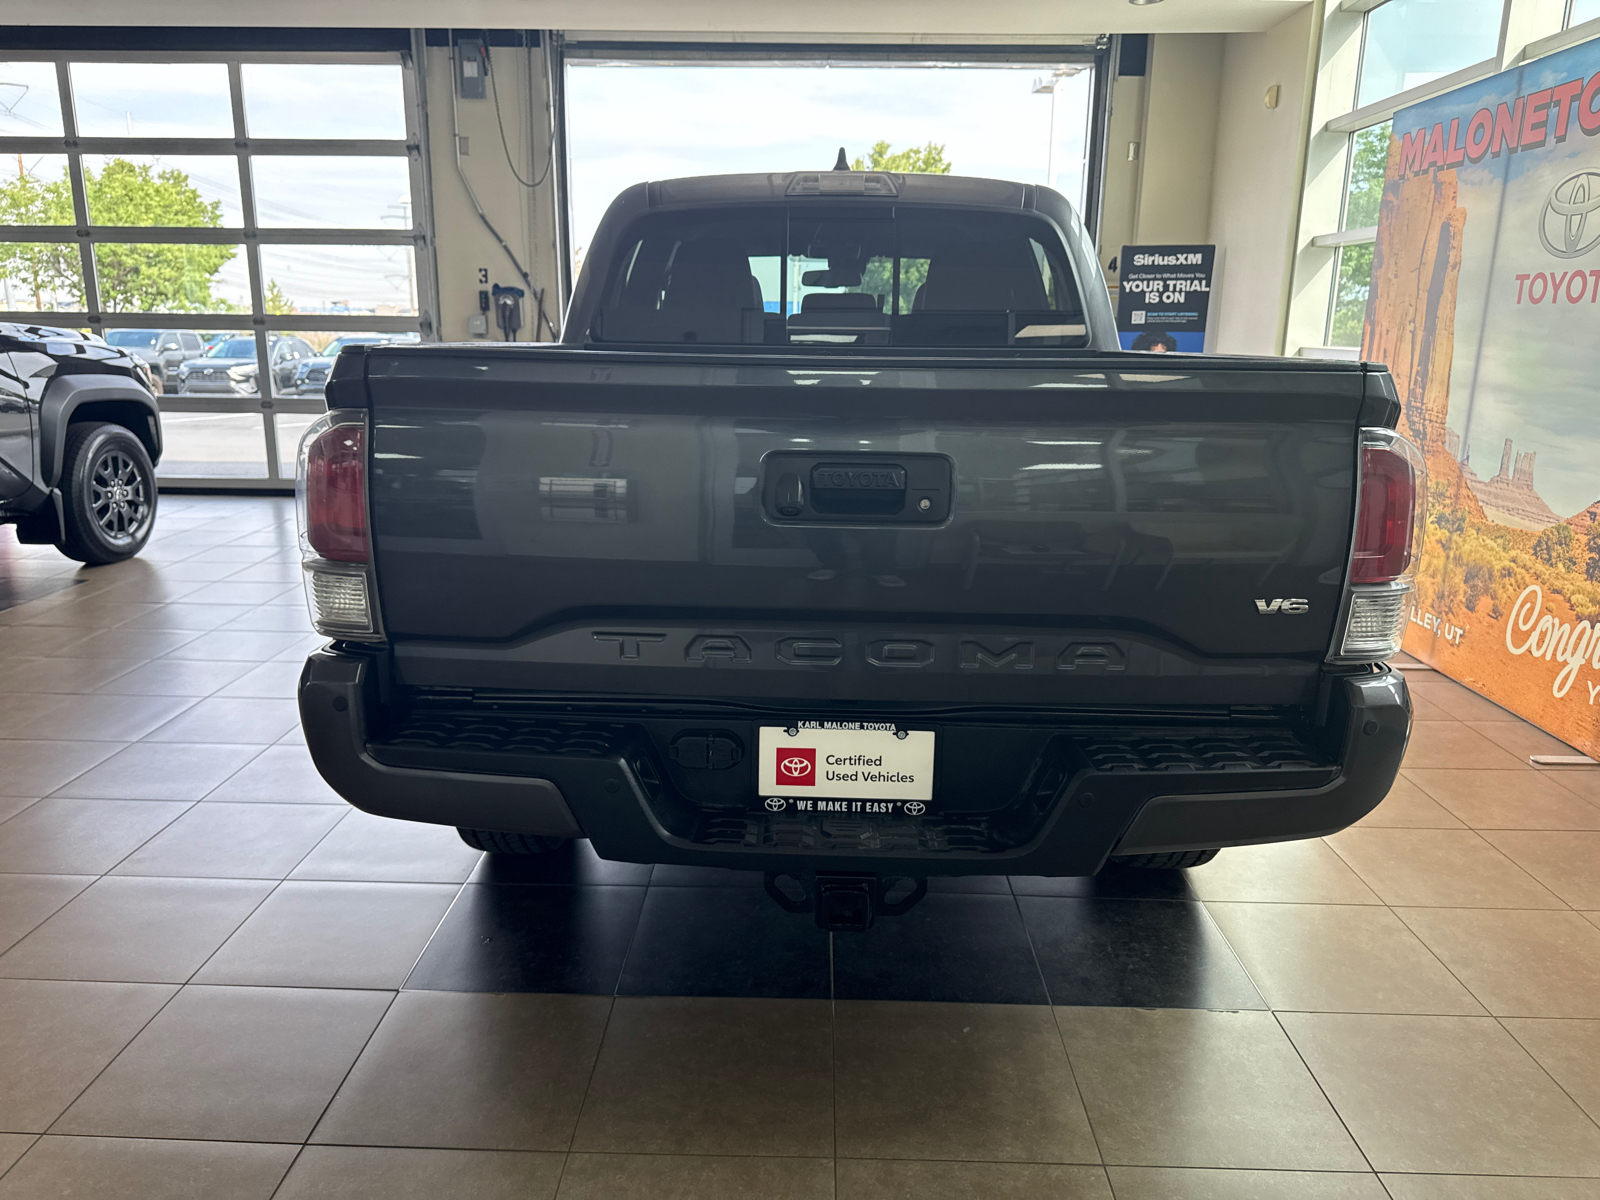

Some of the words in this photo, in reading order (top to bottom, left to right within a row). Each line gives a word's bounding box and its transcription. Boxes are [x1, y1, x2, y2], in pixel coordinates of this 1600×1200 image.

[1108, 256, 1117, 273] 4
[1133, 253, 1202, 266] SiriusXM
[478, 268, 488, 284] 3
[1123, 281, 1164, 292] YOUR
[1166, 280, 1210, 292] TRIAL
[1145, 292, 1160, 304] IS
[1162, 292, 1186, 304] ON
[819, 470, 899, 488] TOYOTA
[1254, 598, 1309, 614] V6
[1444, 622, 1464, 645] UT
[591, 631, 1127, 671] TACOMA
[798, 720, 822, 729] KARL
[824, 722, 860, 730] MALONE
[862, 722, 896, 731] TOYOTA
[825, 754, 882, 767] Certified
[825, 770, 859, 782] Used
[862, 771, 915, 783] Vehicles
[796, 800, 813, 810] WE
[817, 801, 848, 812] MAKE
[852, 802, 862, 812] IT
[866, 802, 894, 812] EASY
